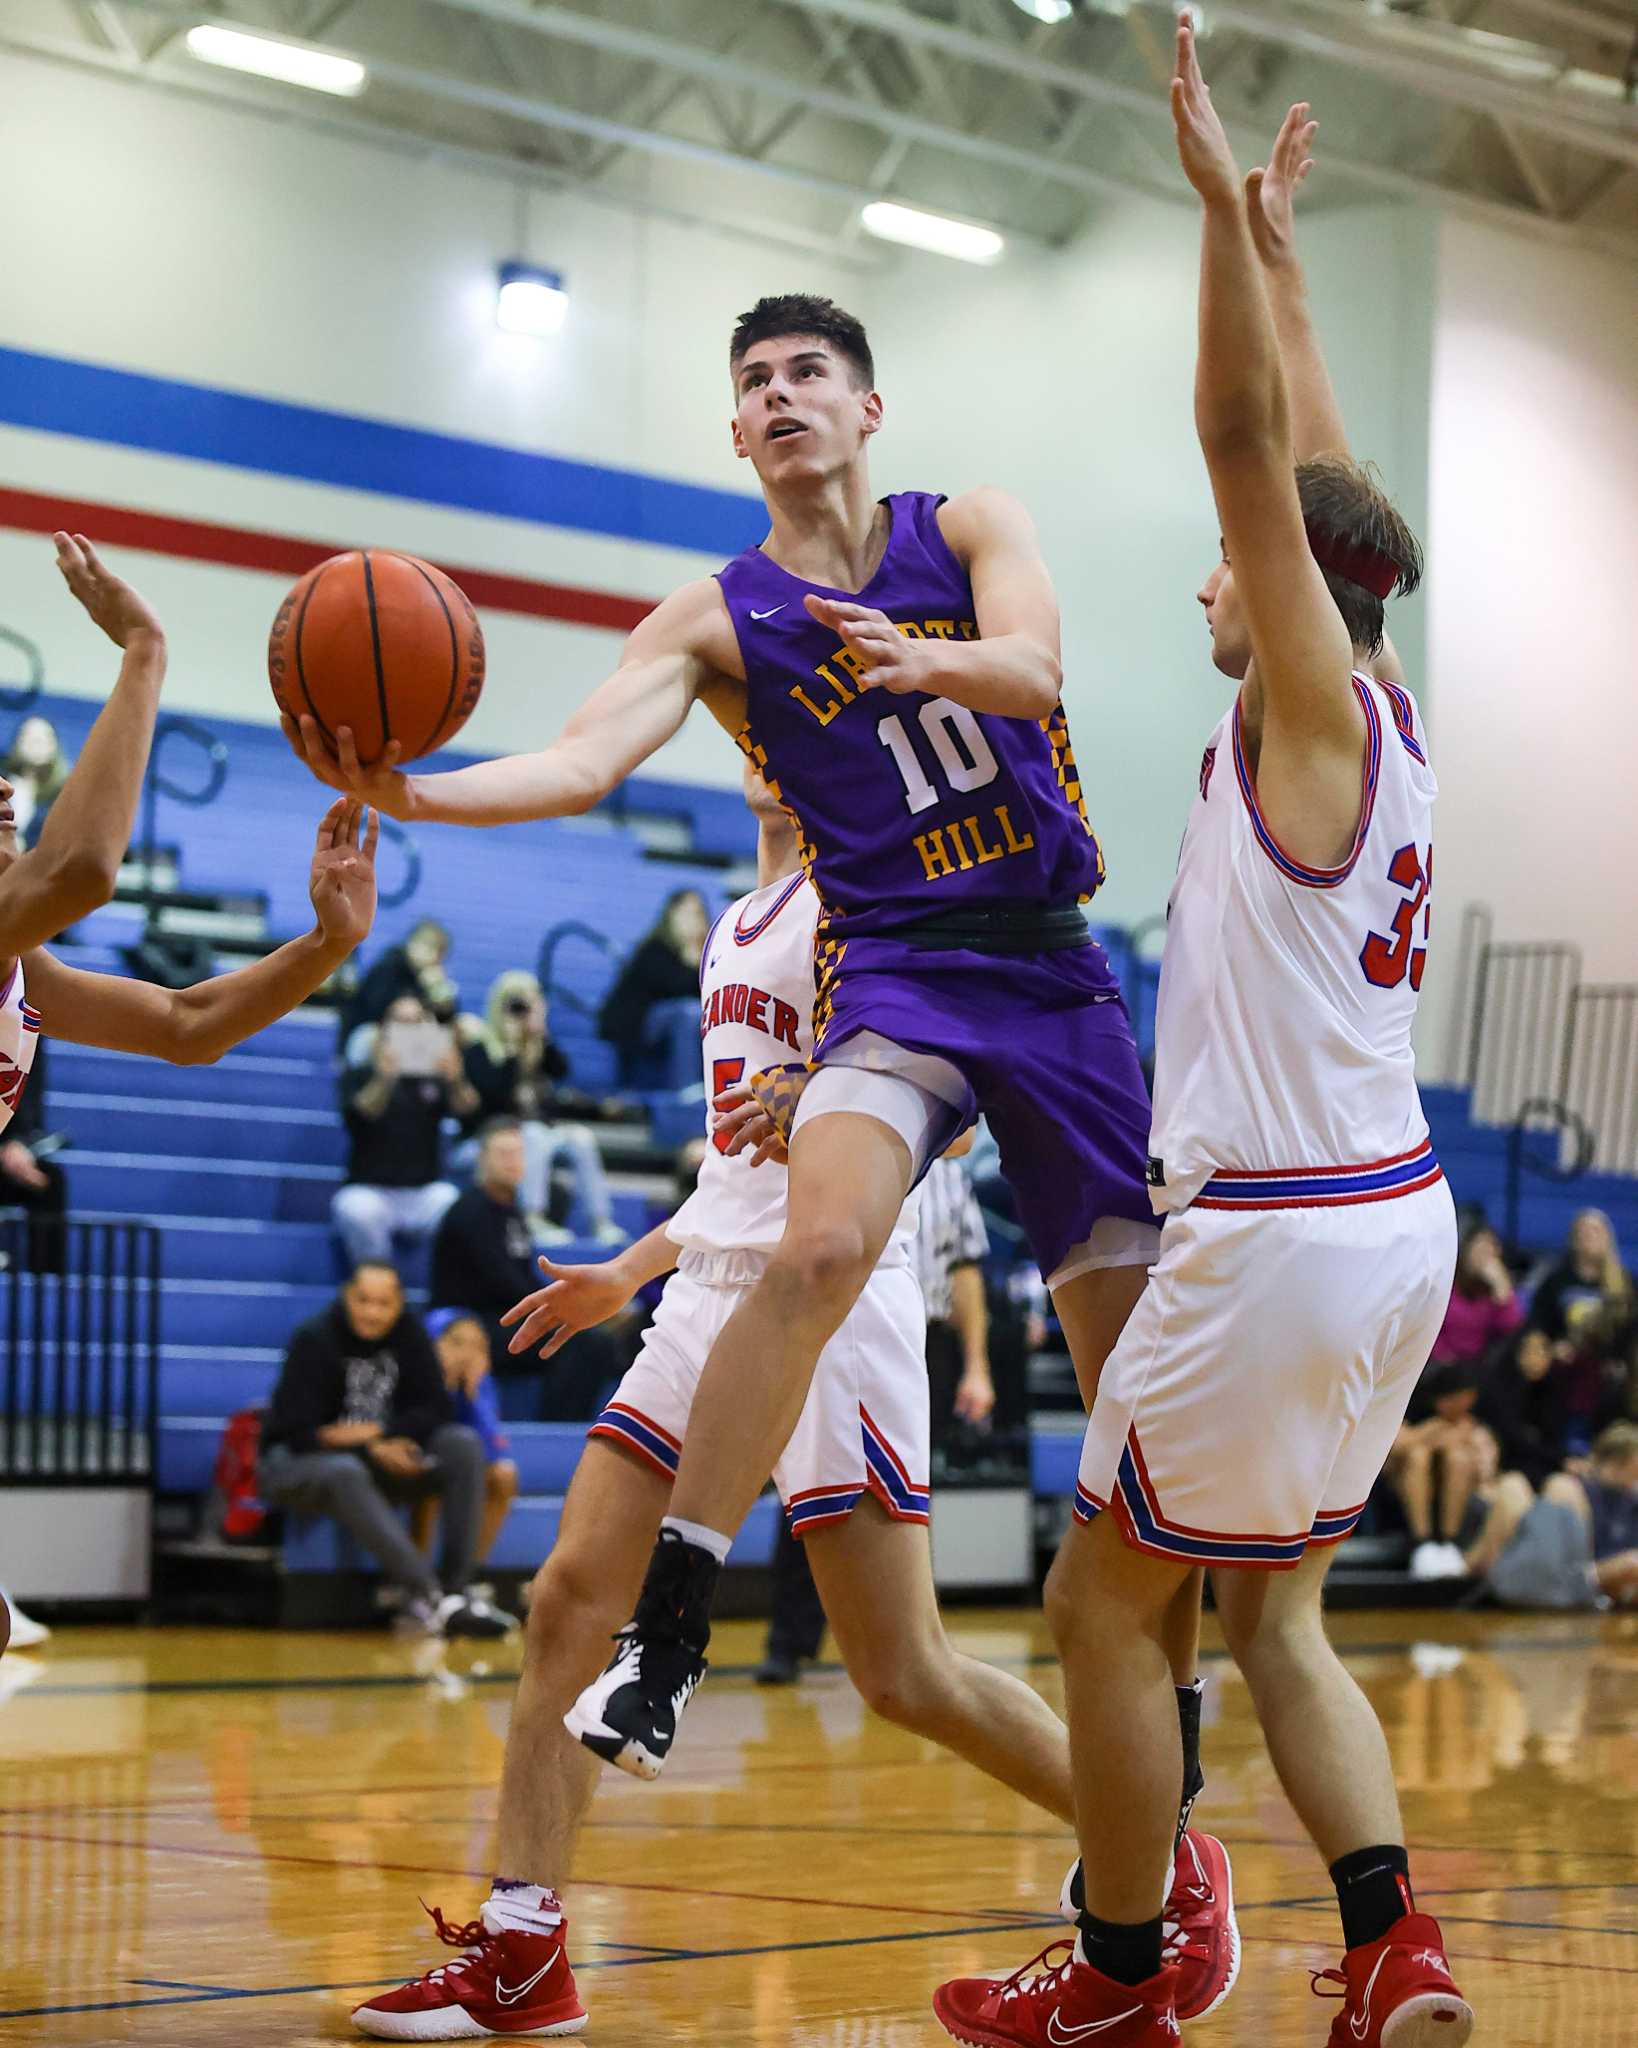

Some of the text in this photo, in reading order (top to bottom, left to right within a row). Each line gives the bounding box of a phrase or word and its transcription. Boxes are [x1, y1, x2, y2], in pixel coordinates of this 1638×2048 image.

[789, 619, 981, 727] LIBT
[878, 697, 999, 814] 10
[913, 806, 1034, 880] HILL
